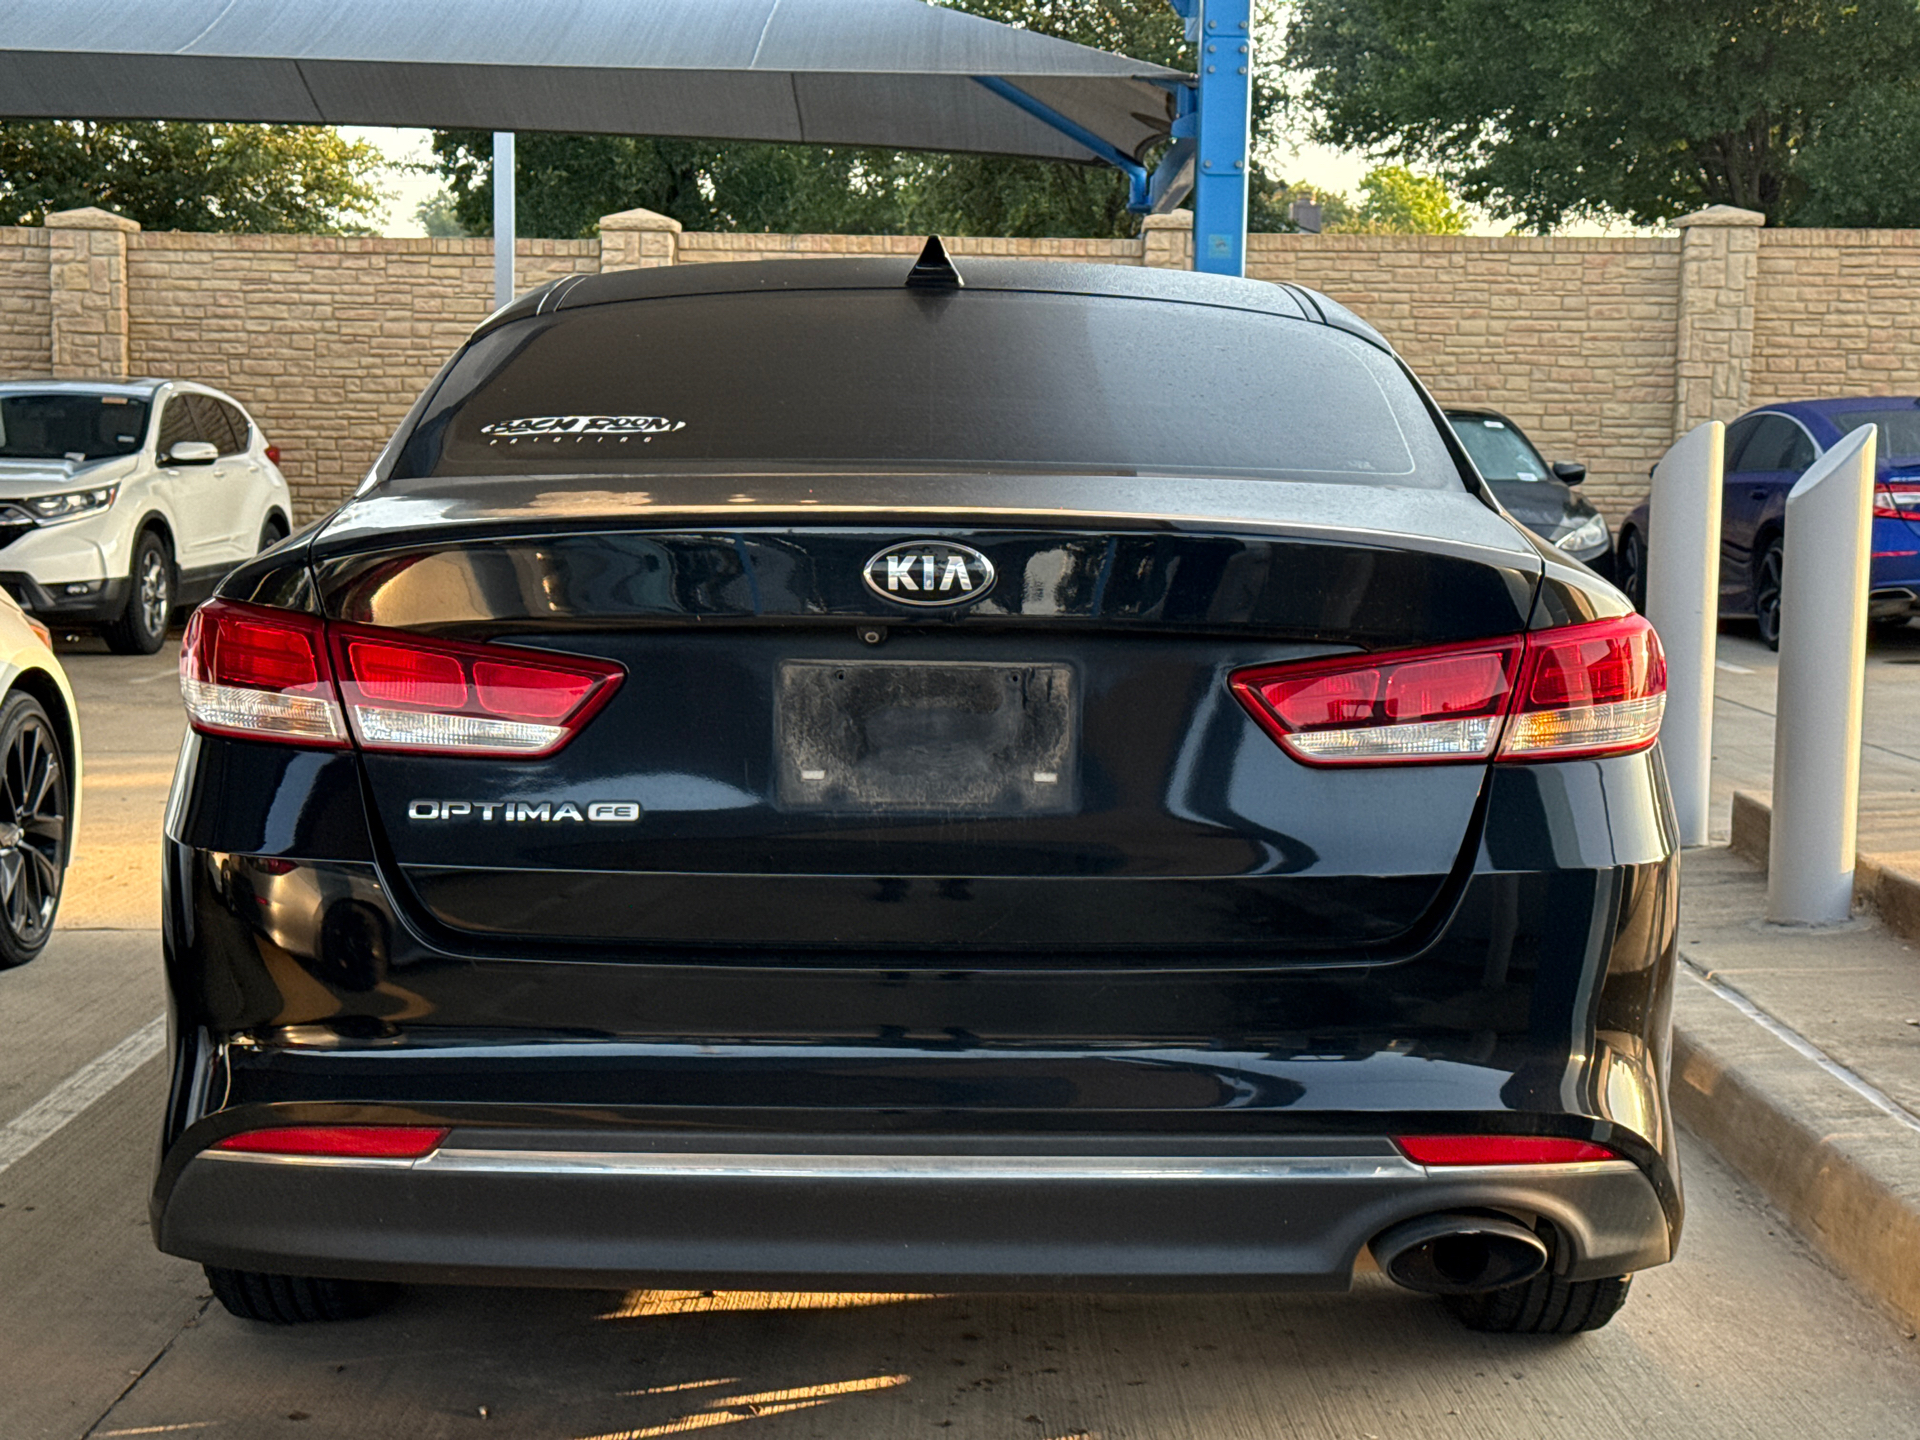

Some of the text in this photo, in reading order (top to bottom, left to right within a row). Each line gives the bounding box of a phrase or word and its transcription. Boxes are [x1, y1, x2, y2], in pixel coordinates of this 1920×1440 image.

[886, 555, 973, 591] KIA
[408, 801, 633, 822] OPTIMA FE
